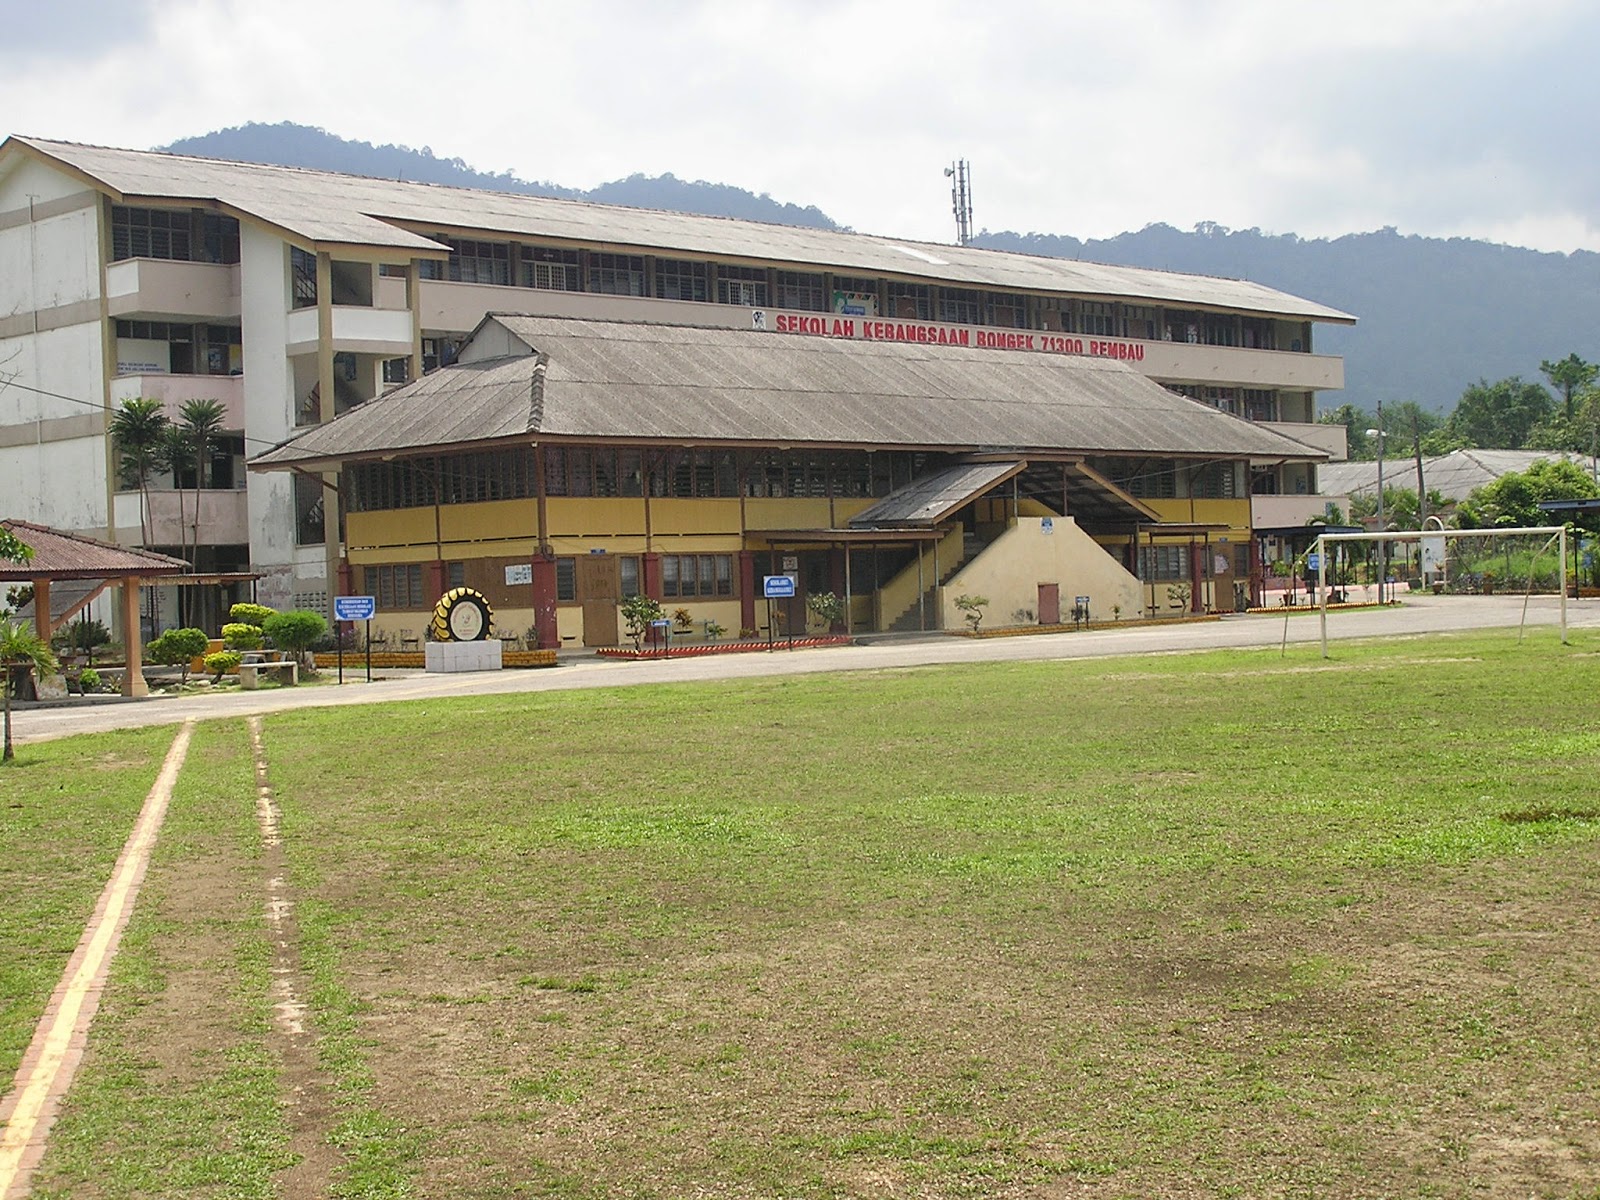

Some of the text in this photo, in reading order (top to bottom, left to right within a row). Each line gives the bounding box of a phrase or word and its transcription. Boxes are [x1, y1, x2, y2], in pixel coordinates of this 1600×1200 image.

[776, 315, 1145, 360] SEKOLAH KEBANGSAAN BONGEK 71300 REMBAU
